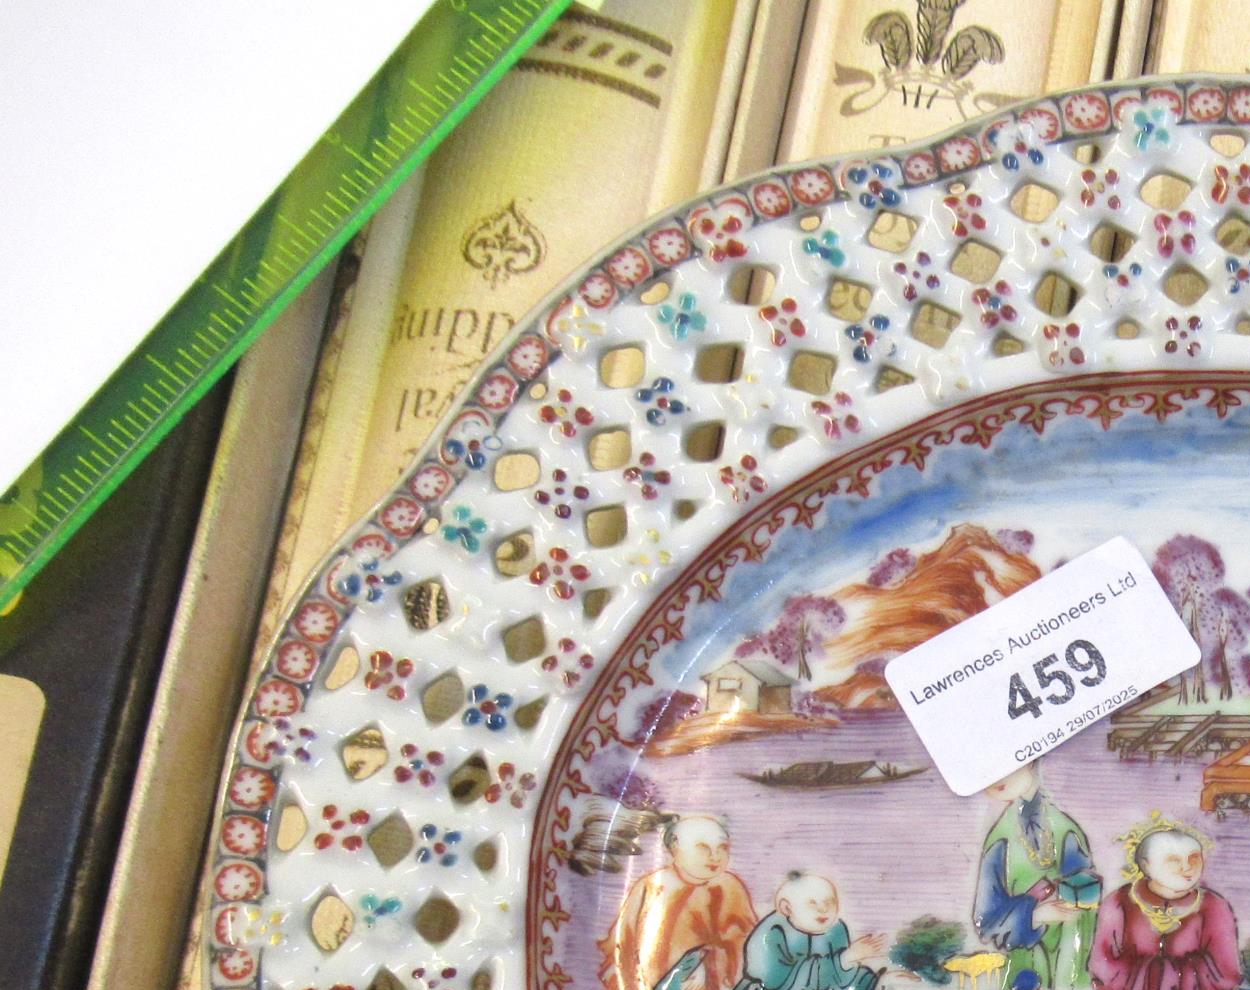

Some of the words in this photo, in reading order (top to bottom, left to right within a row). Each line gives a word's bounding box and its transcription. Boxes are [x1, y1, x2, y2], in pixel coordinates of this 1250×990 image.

[908, 647, 1005, 706] Lawrences
[1007, 591, 1108, 656] Auctioneers
[1105, 570, 1139, 599] Ltd
[1006, 638, 1108, 722] 459
[1014, 726, 1066, 764] C20194
[1064, 684, 1140, 734] 29/07/2025
